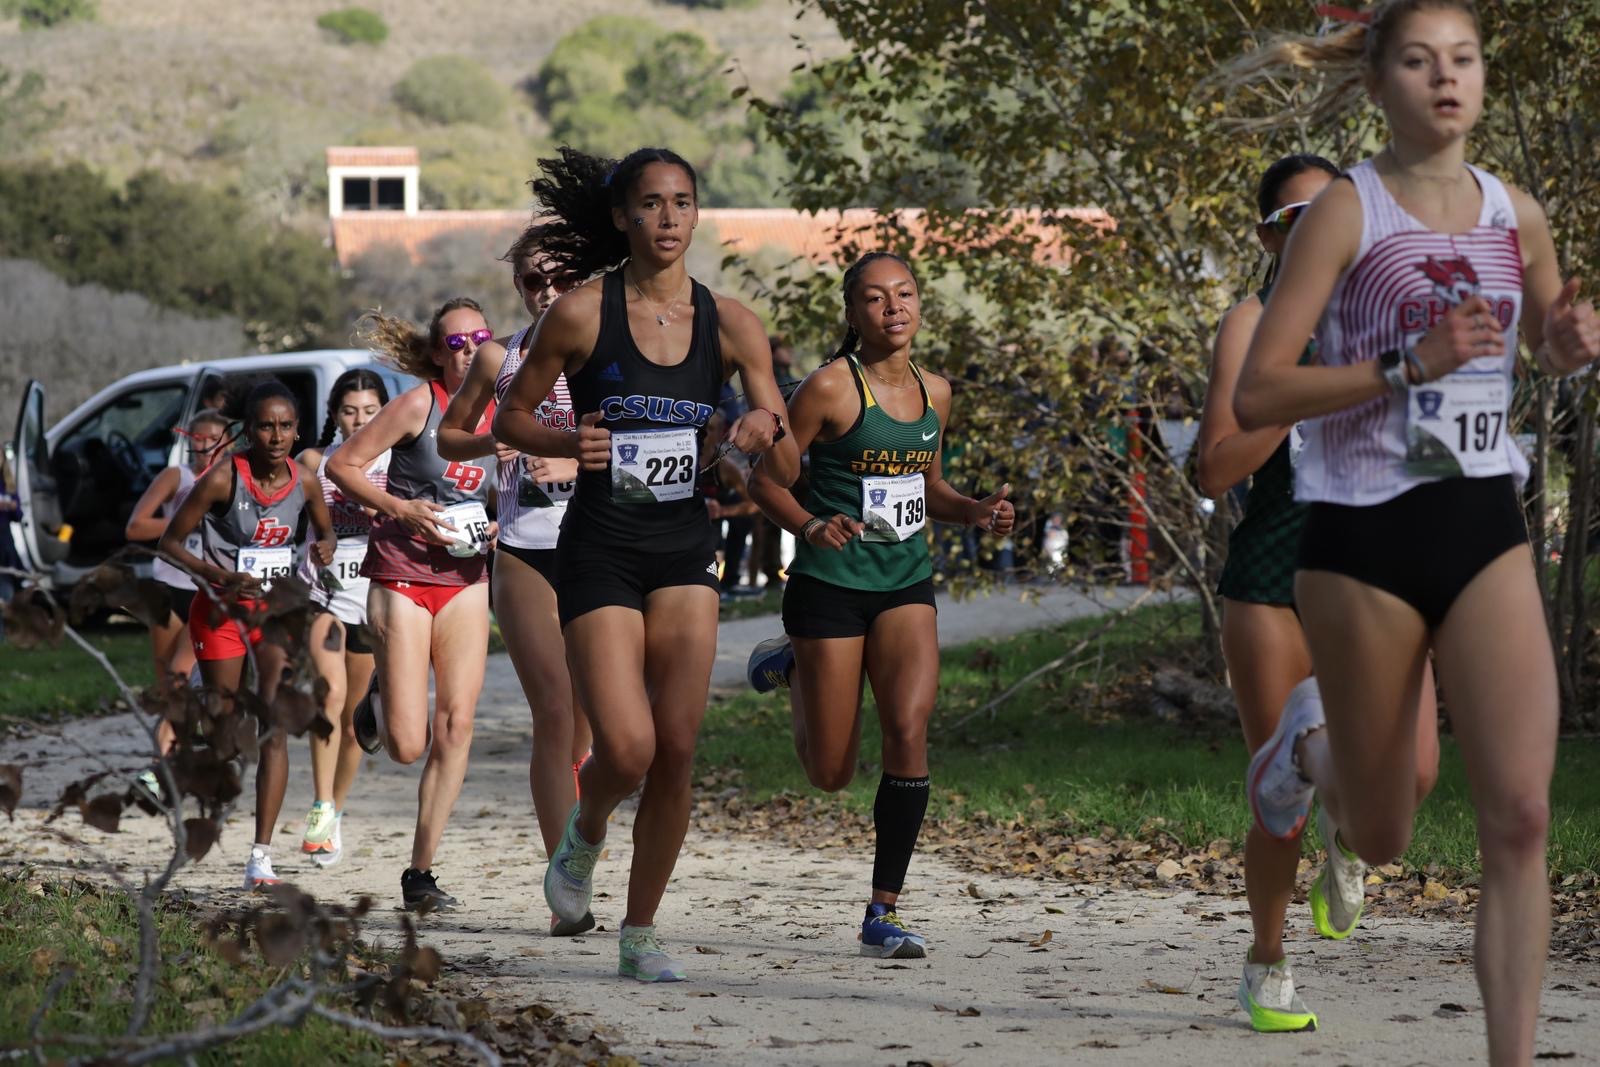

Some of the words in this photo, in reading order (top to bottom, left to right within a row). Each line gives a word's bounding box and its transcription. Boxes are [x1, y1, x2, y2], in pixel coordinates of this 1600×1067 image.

[1399, 296, 1516, 333] CHO
[600, 394, 713, 427] CSUSB
[1455, 412, 1503, 452] 197
[646, 454, 694, 487] 223
[850, 460, 930, 475] POMON
[863, 449, 901, 462] CAL
[905, 450, 938, 463] POL
[893, 496, 924, 527] 139
[250, 516, 292, 548] EB
[338, 561, 362, 580] 19
